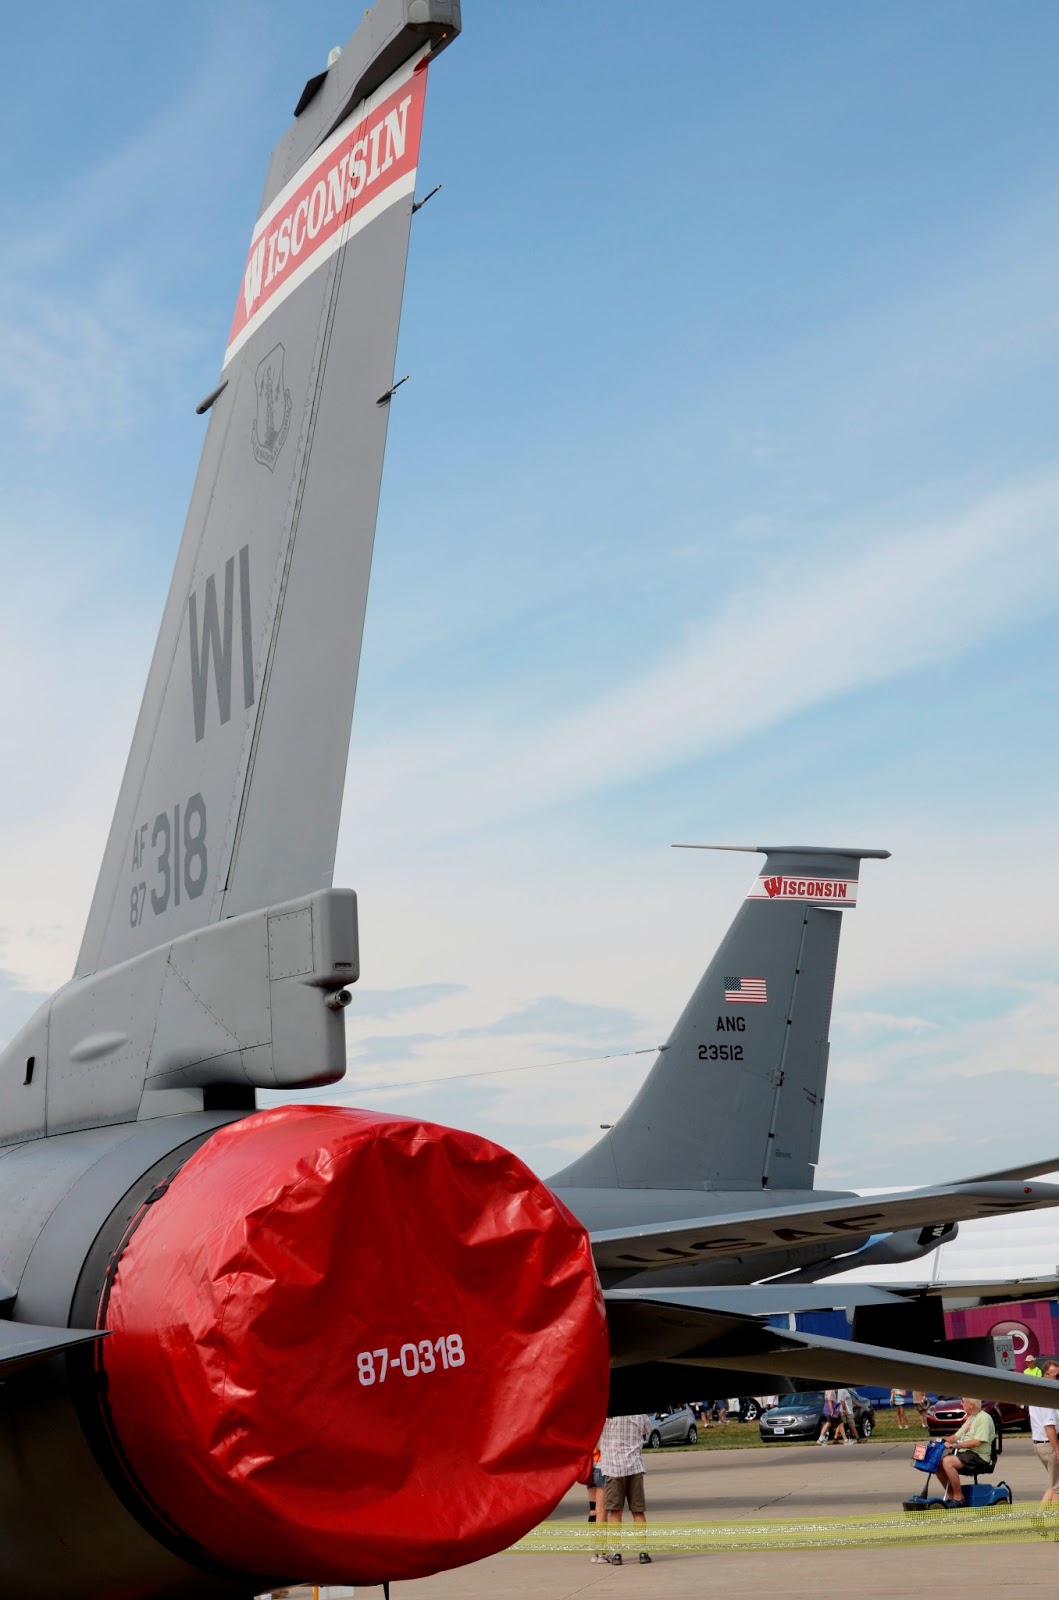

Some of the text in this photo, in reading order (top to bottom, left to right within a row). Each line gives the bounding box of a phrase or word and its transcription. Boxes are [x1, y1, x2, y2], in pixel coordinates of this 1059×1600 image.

[243, 94, 412, 320] WISCONSIN
[188, 543, 255, 745] WI
[131, 822, 149, 873] AF
[150, 791, 209, 917] 318
[129, 880, 147, 929] 87
[763, 875, 848, 899] WISCONSIN
[716, 1016, 746, 1032] ANG
[698, 1044, 744, 1061] 23512
[616, 1213, 885, 1263] USAF
[356, 1333, 466, 1387] 87-0318
